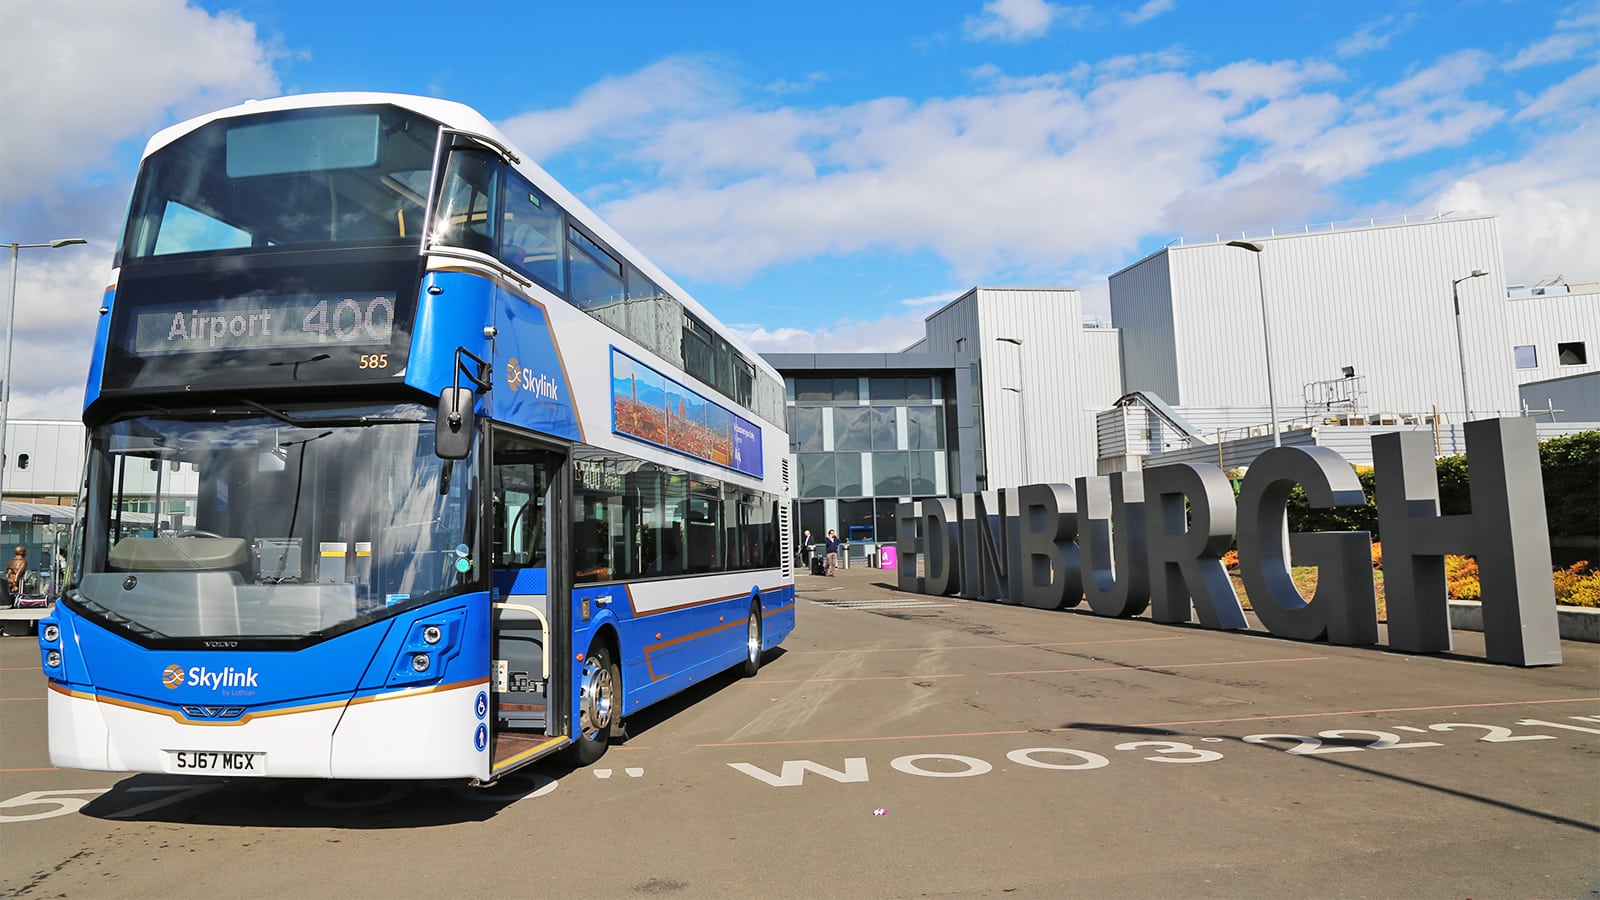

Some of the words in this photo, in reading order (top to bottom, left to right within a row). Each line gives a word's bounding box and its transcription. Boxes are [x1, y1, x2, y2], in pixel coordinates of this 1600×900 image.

[168, 309, 272, 347] Airport
[302, 296, 393, 343] 400
[359, 354, 388, 369] 585
[522, 367, 558, 401] Skylink
[896, 416, 1562, 667] EDINBURGH
[187, 666, 259, 691] Skylink
[177, 752, 218, 769] SJ67
[223, 753, 254, 770] MGX
